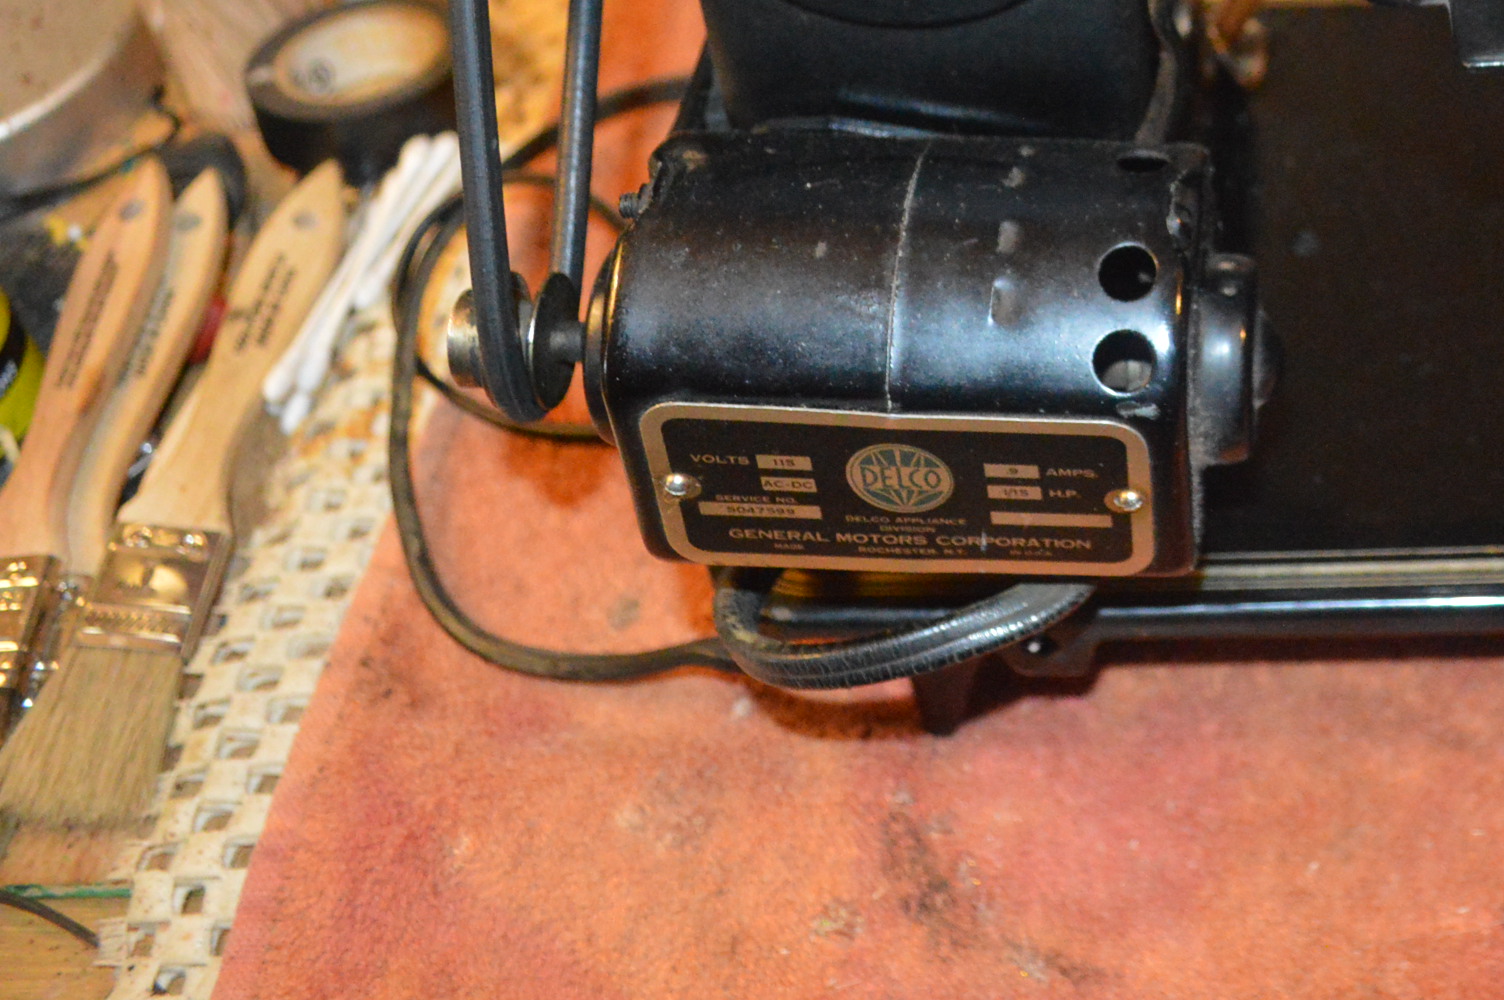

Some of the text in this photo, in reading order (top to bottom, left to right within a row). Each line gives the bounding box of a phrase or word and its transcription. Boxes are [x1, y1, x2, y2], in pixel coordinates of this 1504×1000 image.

[690, 453, 751, 466] VOLTS
[860, 465, 943, 490] DELCO
[763, 480, 814, 490] AC-DC
[715, 494, 771, 504] SERVICE
[845, 514, 966, 525] DELCO APPLIANCE
[728, 528, 1092, 550] GENERAL MOTORS CORPORATION
